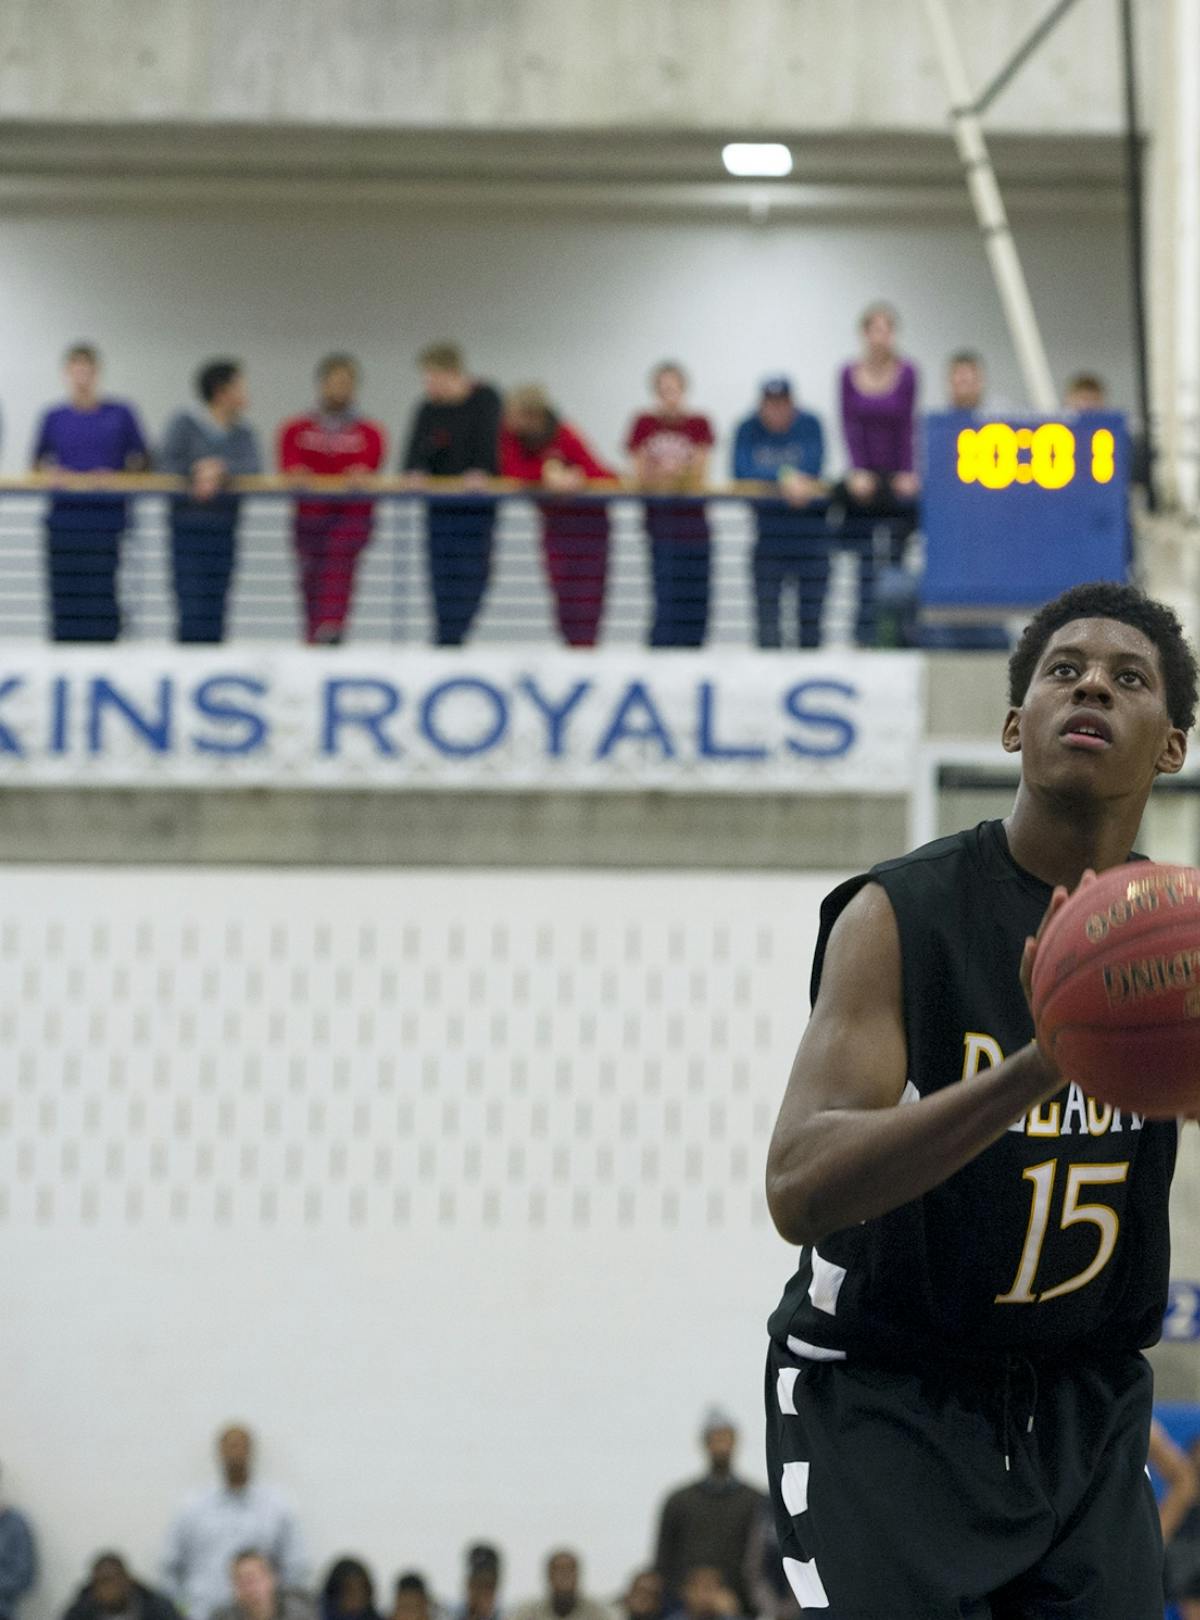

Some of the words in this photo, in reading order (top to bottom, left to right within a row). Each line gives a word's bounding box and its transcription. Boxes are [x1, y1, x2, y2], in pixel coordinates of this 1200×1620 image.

[956, 422, 1115, 490] 10:01
[320, 675, 860, 758] ROYALS
[994, 1157, 1130, 1304] 15
